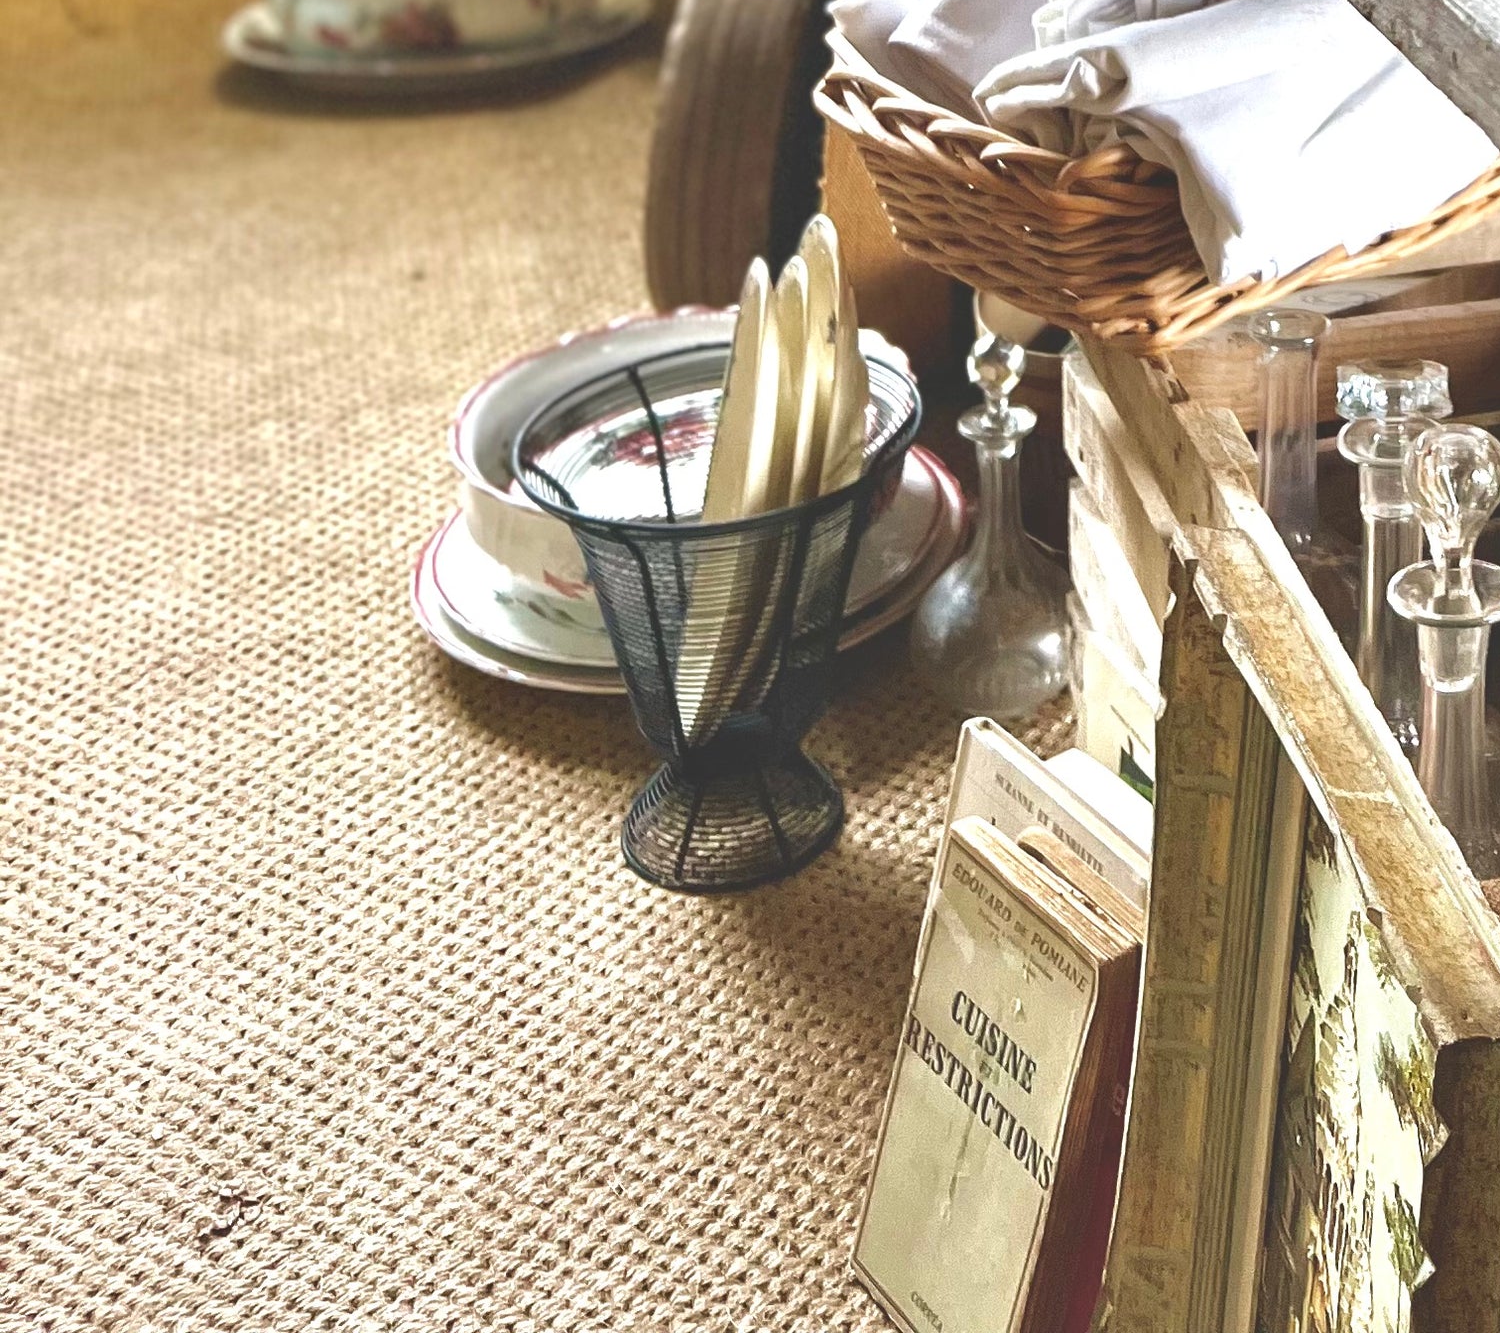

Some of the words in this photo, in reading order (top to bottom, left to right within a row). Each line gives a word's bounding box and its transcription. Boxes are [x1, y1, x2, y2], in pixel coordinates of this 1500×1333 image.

[1030, 932, 1089, 993] POMIANE
[951, 990, 1037, 1094] CUISINE
[905, 1012, 1053, 1191] RESTRICTIONS
